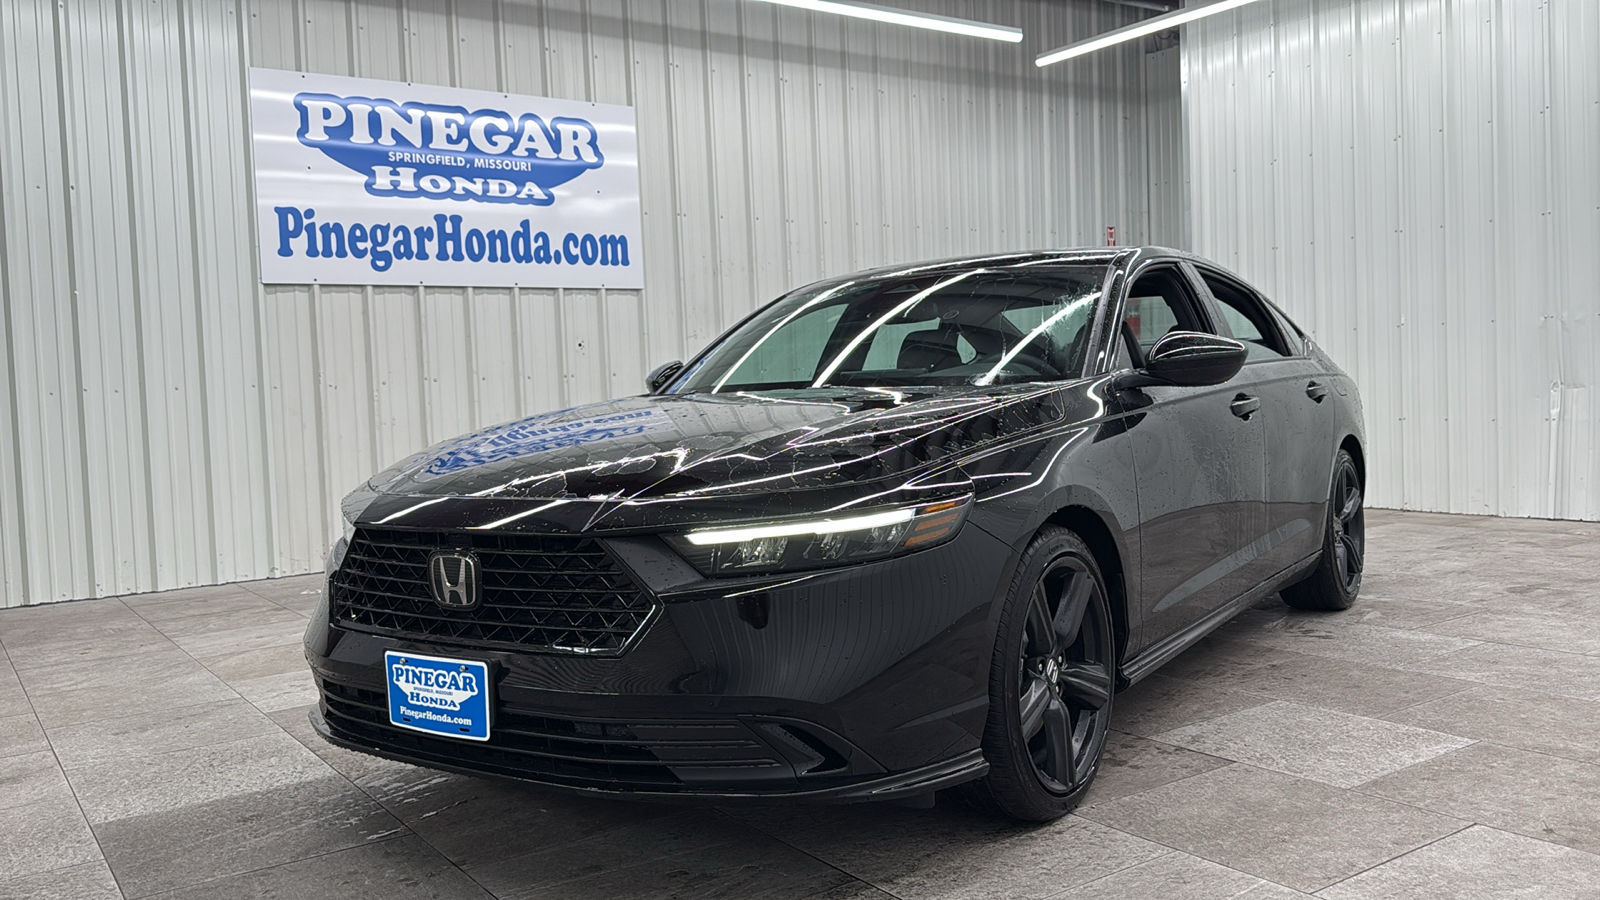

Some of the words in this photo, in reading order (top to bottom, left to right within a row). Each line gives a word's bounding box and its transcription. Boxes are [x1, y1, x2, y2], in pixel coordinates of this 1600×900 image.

[301, 99, 599, 164] PINEGAR
[388, 150, 471, 169] SPRINGFIELD,
[474, 157, 532, 173] MISSOURI
[370, 165, 550, 200] HONDA
[274, 206, 630, 272] PinegarHonda.com
[393, 666, 476, 693] PINEGAR
[409, 691, 458, 708] HONDA
[399, 705, 472, 726] PinegarHonda.com
